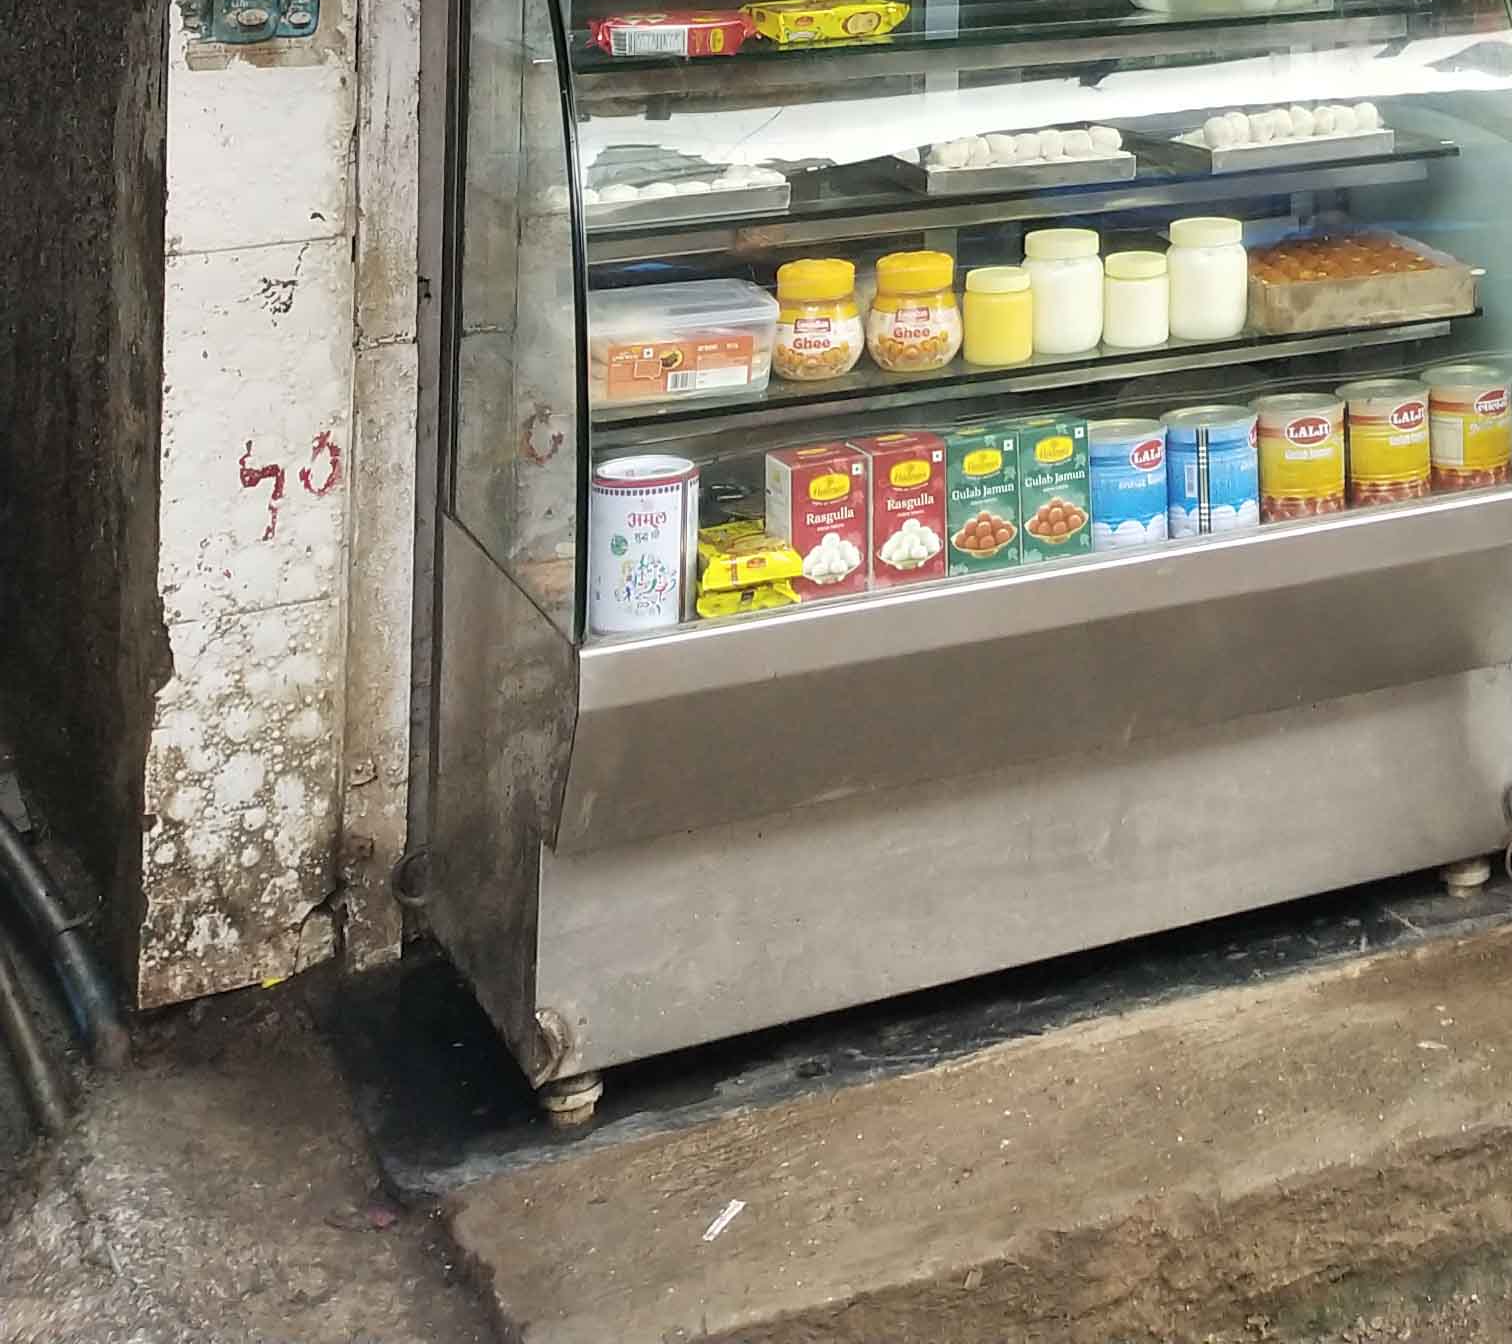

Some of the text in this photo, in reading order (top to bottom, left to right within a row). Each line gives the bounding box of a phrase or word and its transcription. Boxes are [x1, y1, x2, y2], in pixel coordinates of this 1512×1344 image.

[893, 327, 931, 339] Ghee
[792, 337, 831, 350] Ghee
[1286, 424, 1332, 444] LALJI
[1024, 468, 1086, 489] Gulab Jamun
[951, 481, 1015, 502] Gulab Jamun
[886, 493, 935, 512] Rasgulla
[805, 506, 855, 526] Rasgulla
